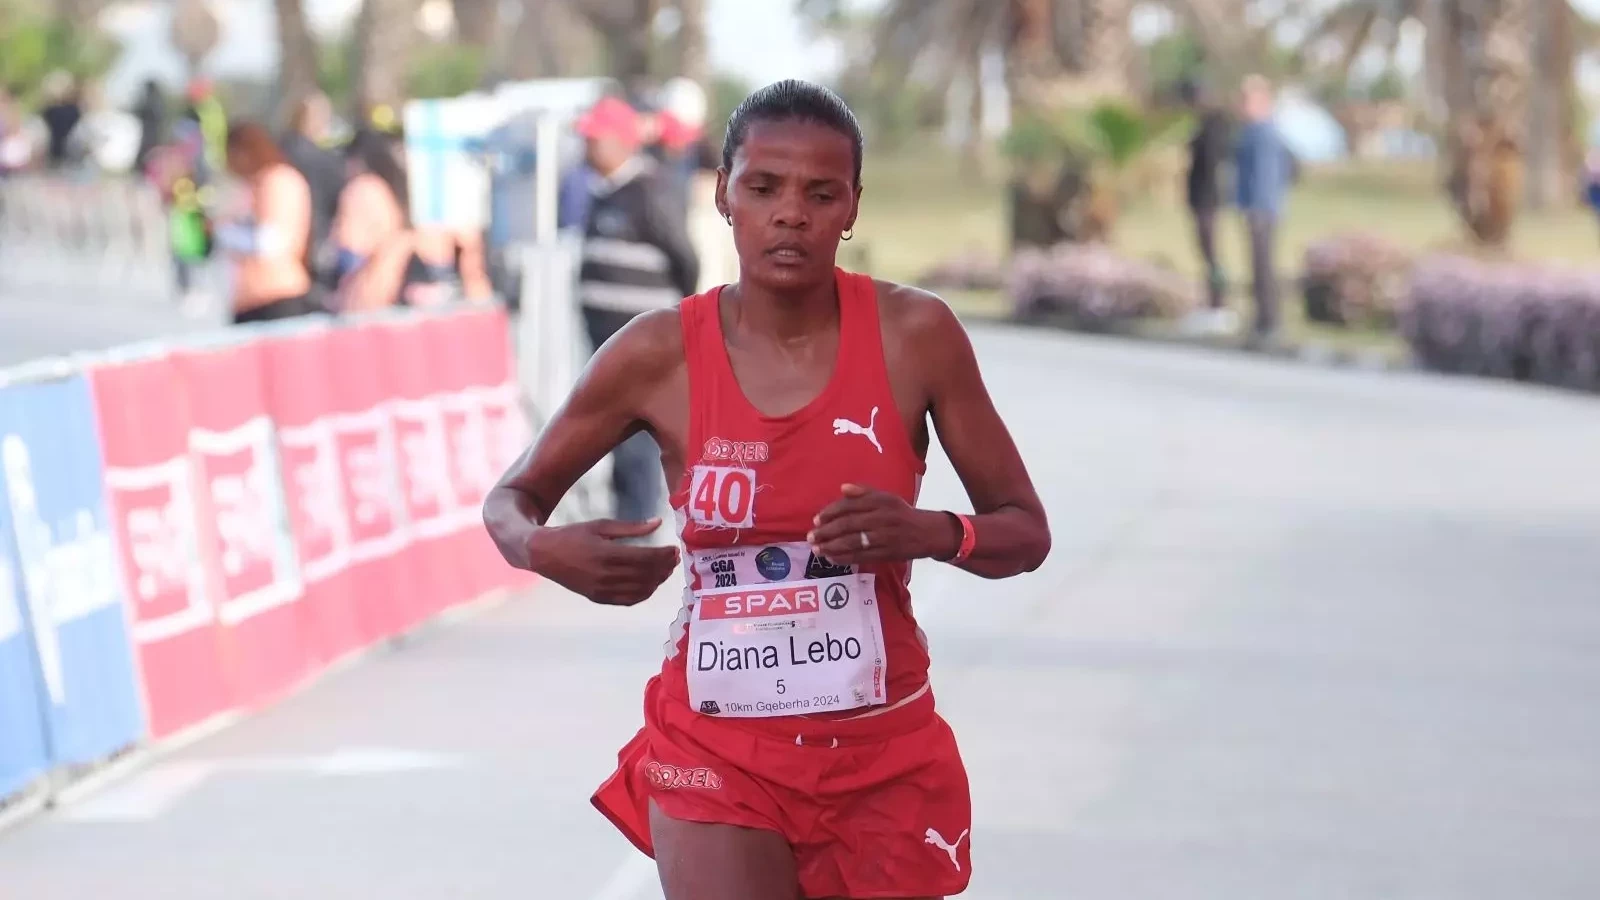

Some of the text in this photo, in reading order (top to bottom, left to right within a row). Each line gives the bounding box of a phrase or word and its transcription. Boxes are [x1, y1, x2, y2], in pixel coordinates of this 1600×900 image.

[703, 437, 769, 461] BOXER
[694, 470, 752, 524] 40
[711, 560, 735, 573] CGA
[715, 573, 737, 588] 2024
[724, 590, 816, 615] SPAR
[698, 641, 779, 671] Diana
[790, 633, 861, 665] Lebo
[776, 679, 786, 694] 5
[701, 701, 718, 710] ASA
[725, 702, 753, 713] 10km
[756, 698, 810, 714] Gqeberha
[813, 695, 840, 708] 2024
[645, 762, 722, 790] BOXER
